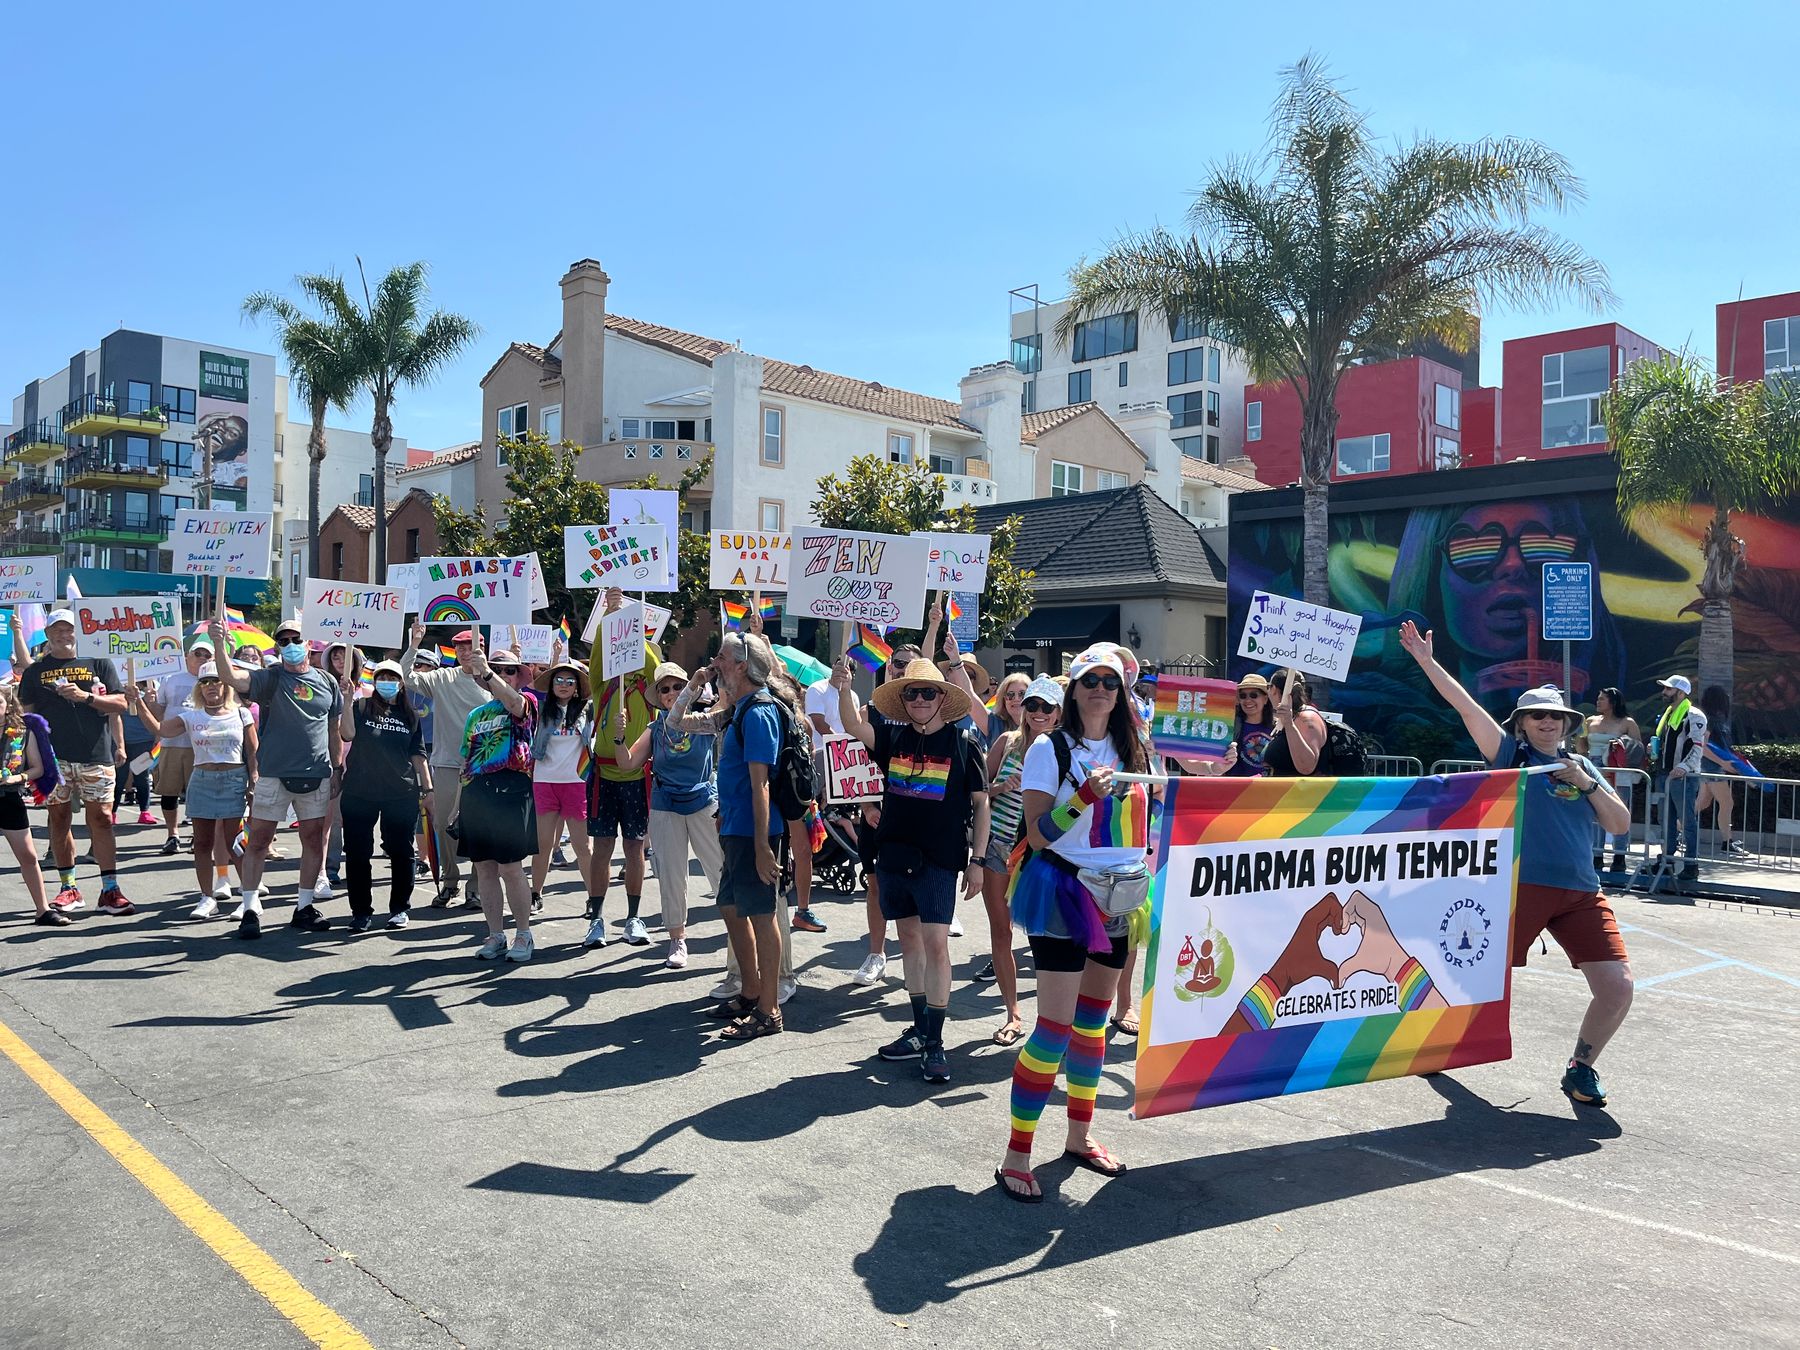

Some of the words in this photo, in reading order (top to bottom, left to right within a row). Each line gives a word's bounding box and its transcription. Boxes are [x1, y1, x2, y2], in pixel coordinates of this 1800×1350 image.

[184, 519, 266, 535] ENLIGHTEN
[583, 526, 618, 547] EAT
[205, 539, 225, 550] UP
[589, 536, 639, 561] DRINK
[720, 534, 792, 550] BUDDHA
[227, 553, 244, 562] got
[580, 546, 659, 584] MEDITATE
[740, 551, 769, 561] FOR
[803, 535, 887, 578] ZEN
[929, 550, 960, 564] en
[961, 549, 985, 564] out
[0, 565, 34, 577] KIND
[186, 563, 216, 572] PRIDE
[428, 559, 526, 582] NAMASTE
[730, 563, 787, 586] ALL
[939, 566, 964, 582] Pride
[1561, 567, 1588, 575] PARKING
[3, 580, 19, 589] and
[457, 579, 510, 600] GAY!
[827, 576, 893, 600] OUT
[0, 590, 43, 601] INDFUL
[317, 589, 400, 612] MEDITATE
[79, 601, 175, 635] Buddhaful
[815, 604, 841, 613] WITH
[851, 605, 895, 618] PRIDE!
[1255, 595, 1287, 616] Think
[1293, 609, 1317, 622] good
[1322, 611, 1357, 636] thoughts
[351, 618, 370, 630] hate
[1249, 615, 1285, 637] Speak
[1289, 628, 1310, 642] good
[1317, 634, 1345, 651] words
[109, 633, 150, 655] Proud
[1247, 636, 1265, 655] Do
[1269, 644, 1298, 659] good
[1303, 648, 1338, 671] deeds
[40, 669, 64, 679] START
[121, 655, 174, 672] KNDNESS
[1177, 690, 1208, 713] BE
[1162, 714, 1229, 740] KIND
[1189, 849, 1316, 898] DHARMA
[1324, 843, 1388, 886] BUM
[1396, 839, 1498, 880] TEMPLE
[1439, 897, 1492, 933] BUDDHA
[1180, 953, 1192, 962] DBT
[1439, 939, 1464, 969] FOR
[1466, 936, 1490, 968] YOU
[1276, 990, 1357, 1018] CELEBRATES
[1360, 985, 1398, 1008] PRIDE!
